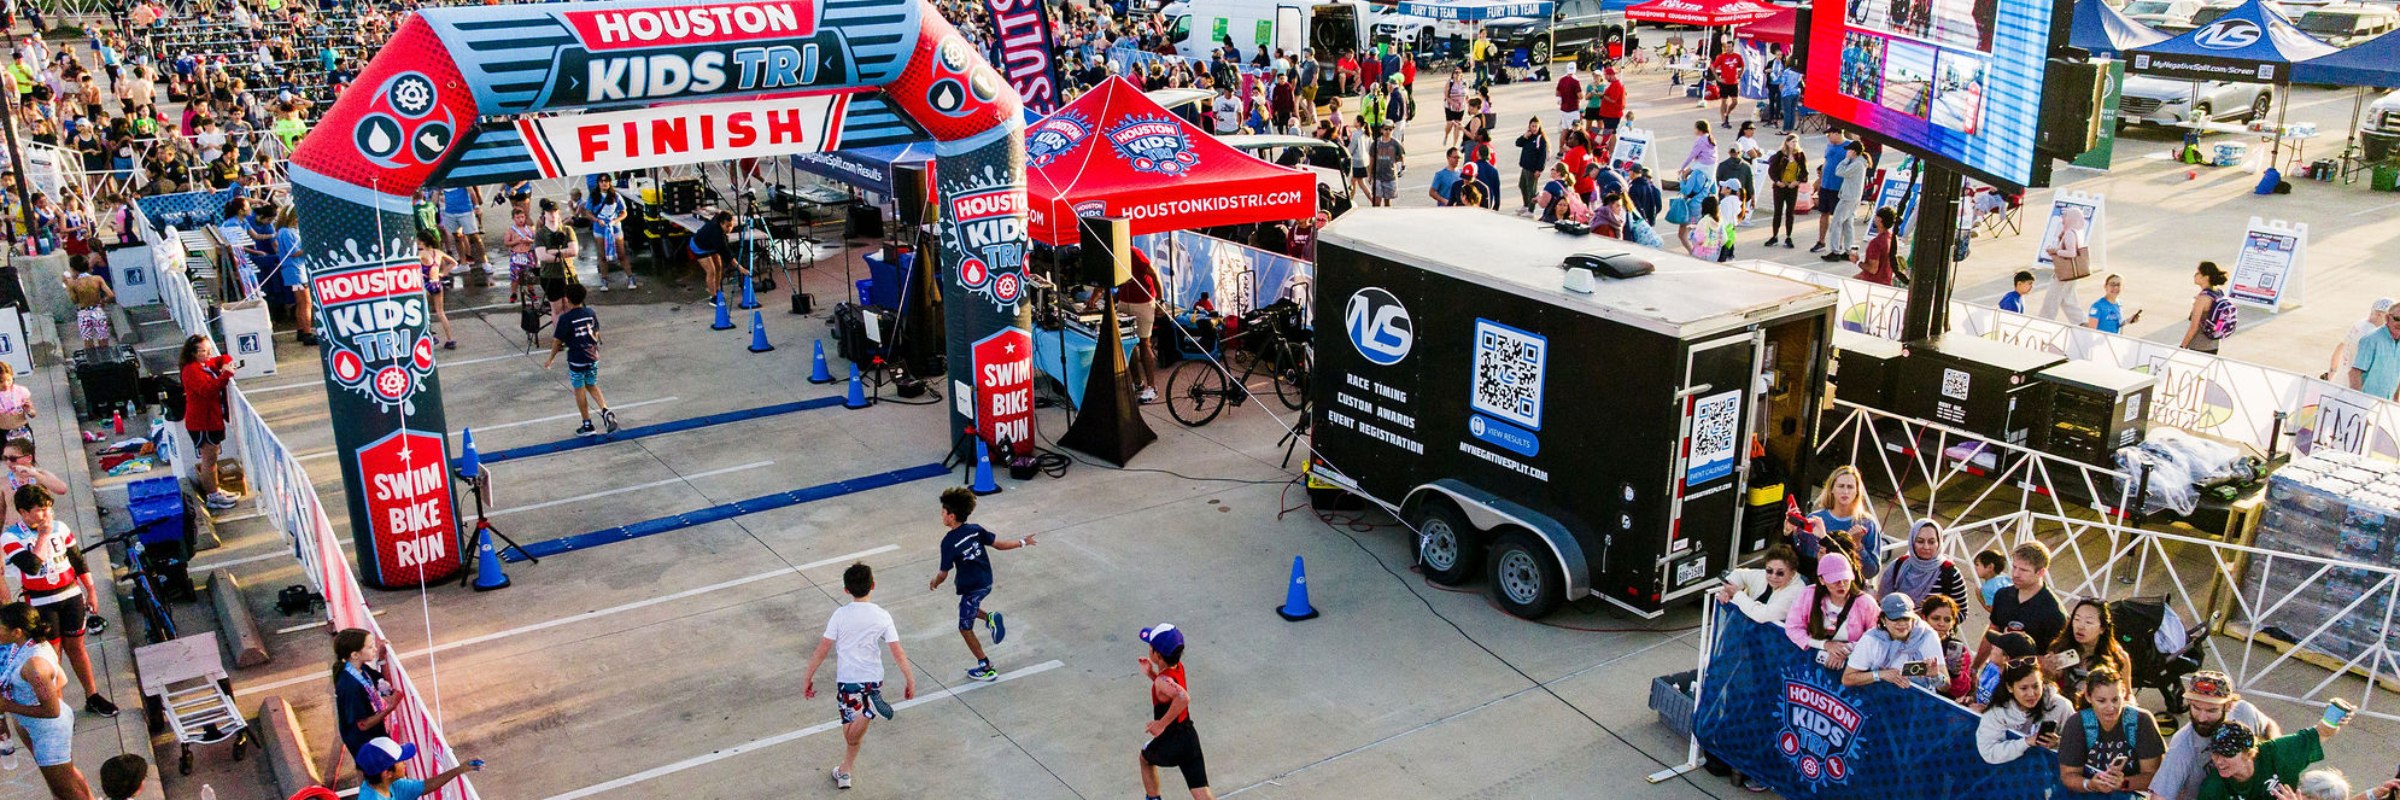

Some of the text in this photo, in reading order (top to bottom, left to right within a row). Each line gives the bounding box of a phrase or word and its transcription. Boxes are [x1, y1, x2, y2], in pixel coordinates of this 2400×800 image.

[594, 5, 798, 43] HOUSTON
[1411, 5, 1457, 18] FURY TRI TEAM
[1487, 3, 1539, 18] FURY TRI TEAM
[587, 44, 819, 101] KIDS TRI
[2152, 60, 2255, 75] MyNegativeSplit.com/Screen
[578, 108, 804, 163] FINISH
[1035, 131, 1067, 151] KIDS
[1045, 120, 1083, 142] HOUSTON
[1116, 124, 1176, 143] HOUSTON
[1129, 135, 1179, 155] KIDS
[1144, 146, 1174, 163] TRI
[1076, 203, 1104, 214] HOUSTON
[1121, 190, 1302, 222] HOUSTONKIDSTRI.COM
[966, 216, 1029, 248] KIDS
[982, 242, 1022, 270] TRI
[318, 267, 422, 301] HOUSTON
[332, 298, 423, 338] KIDS
[352, 328, 411, 363] TRI
[983, 356, 1031, 387] SWIM
[992, 387, 1029, 416] BIKE
[1346, 373, 1407, 404] RACE TIMING
[1337, 391, 1416, 430] CUSTOM AWARDS
[995, 416, 1029, 446] RUN
[1328, 410, 1424, 456] EVENT REGISTRATION
[1487, 426, 1531, 449] VIEW RESULTS
[1459, 441, 1549, 482] MYNEGATIVESPLIT.COM
[1705, 463, 1732, 476] CALENDAR
[373, 461, 442, 501] SWIM
[388, 497, 442, 534] BIKE
[396, 531, 446, 568] RUN
[1789, 686, 1857, 729] HOUSTON
[1792, 706, 1845, 748] KIDS
[1798, 727, 1831, 759] TRI
